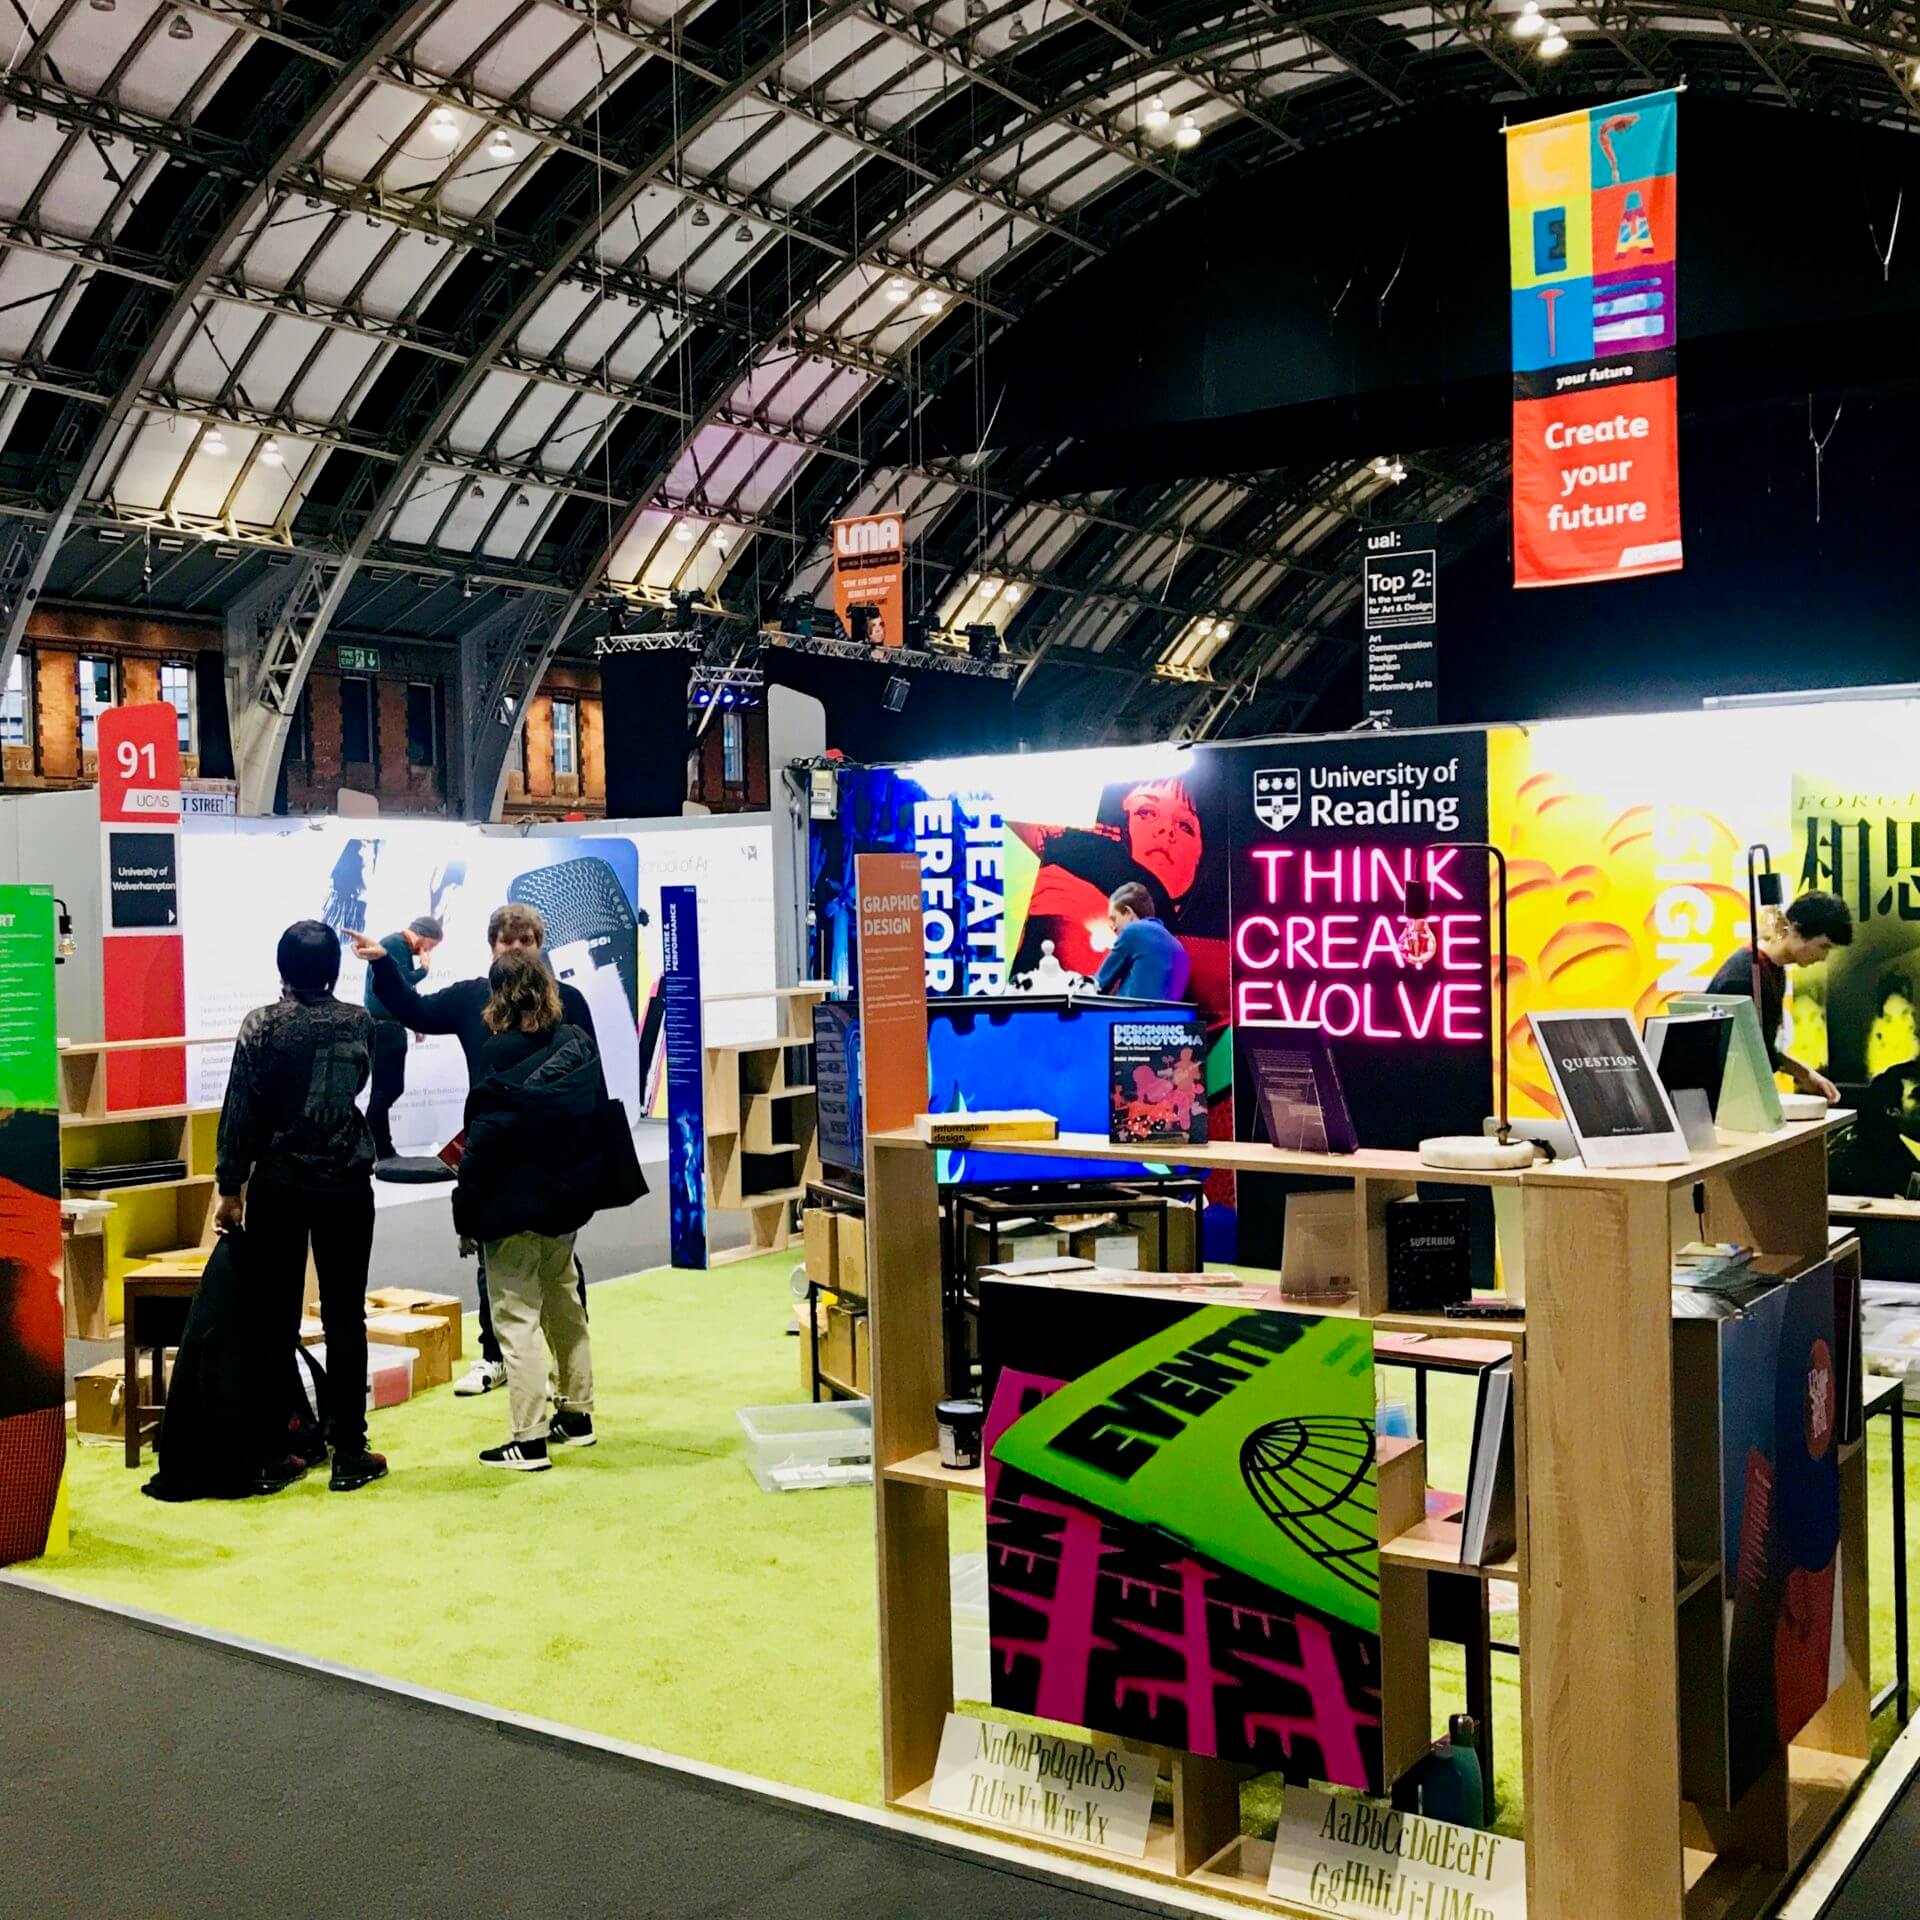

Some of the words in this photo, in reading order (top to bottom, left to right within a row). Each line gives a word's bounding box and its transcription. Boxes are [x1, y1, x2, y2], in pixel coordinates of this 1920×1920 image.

[1556, 373, 1587, 391] your
[1590, 364, 1633, 382] future
[1544, 414, 1649, 450] Create
[1560, 460, 1632, 497] your
[1547, 500, 1647, 532] future
[837, 518, 900, 555] LMA
[1367, 531, 1401, 550] ual:
[1368, 573, 1406, 594] Top
[1411, 568, 1432, 588] 2:
[1381, 604, 1395, 613] Art
[1403, 601, 1433, 612] Design
[1392, 592, 1416, 603] world
[1368, 634, 1382, 643] Art
[1368, 641, 1433, 653] Communication
[1368, 682, 1414, 692] Performing
[1414, 680, 1433, 689] Arts
[117, 741, 157, 780] 91
[1310, 763, 1428, 790] University
[1433, 758, 1459, 783] of
[136, 795, 170, 808] UCAS
[192, 797, 224, 812] STREET
[1311, 789, 1460, 832] Reading
[118, 866, 158, 880] University
[160, 866, 169, 876] of
[1252, 846, 1464, 904] THINK
[112, 881, 176, 893] Wolverhampton
[863, 894, 920, 914] GRAPHIC
[669, 903, 679, 972] PERFORMANCE
[864, 917, 912, 937] DESIGN
[663, 930, 672, 973] THEATRE
[1238, 979, 1484, 1040] EVOLVE
[1562, 1055, 1638, 1073] QUESTION
[934, 1133, 966, 1142] design
[1410, 1235, 1456, 1247] SUPERBUG
[974, 1722, 1127, 1793] NnOoPpQqRrSs
[1319, 1797, 1502, 1881] AaBbCcDdEeFf
